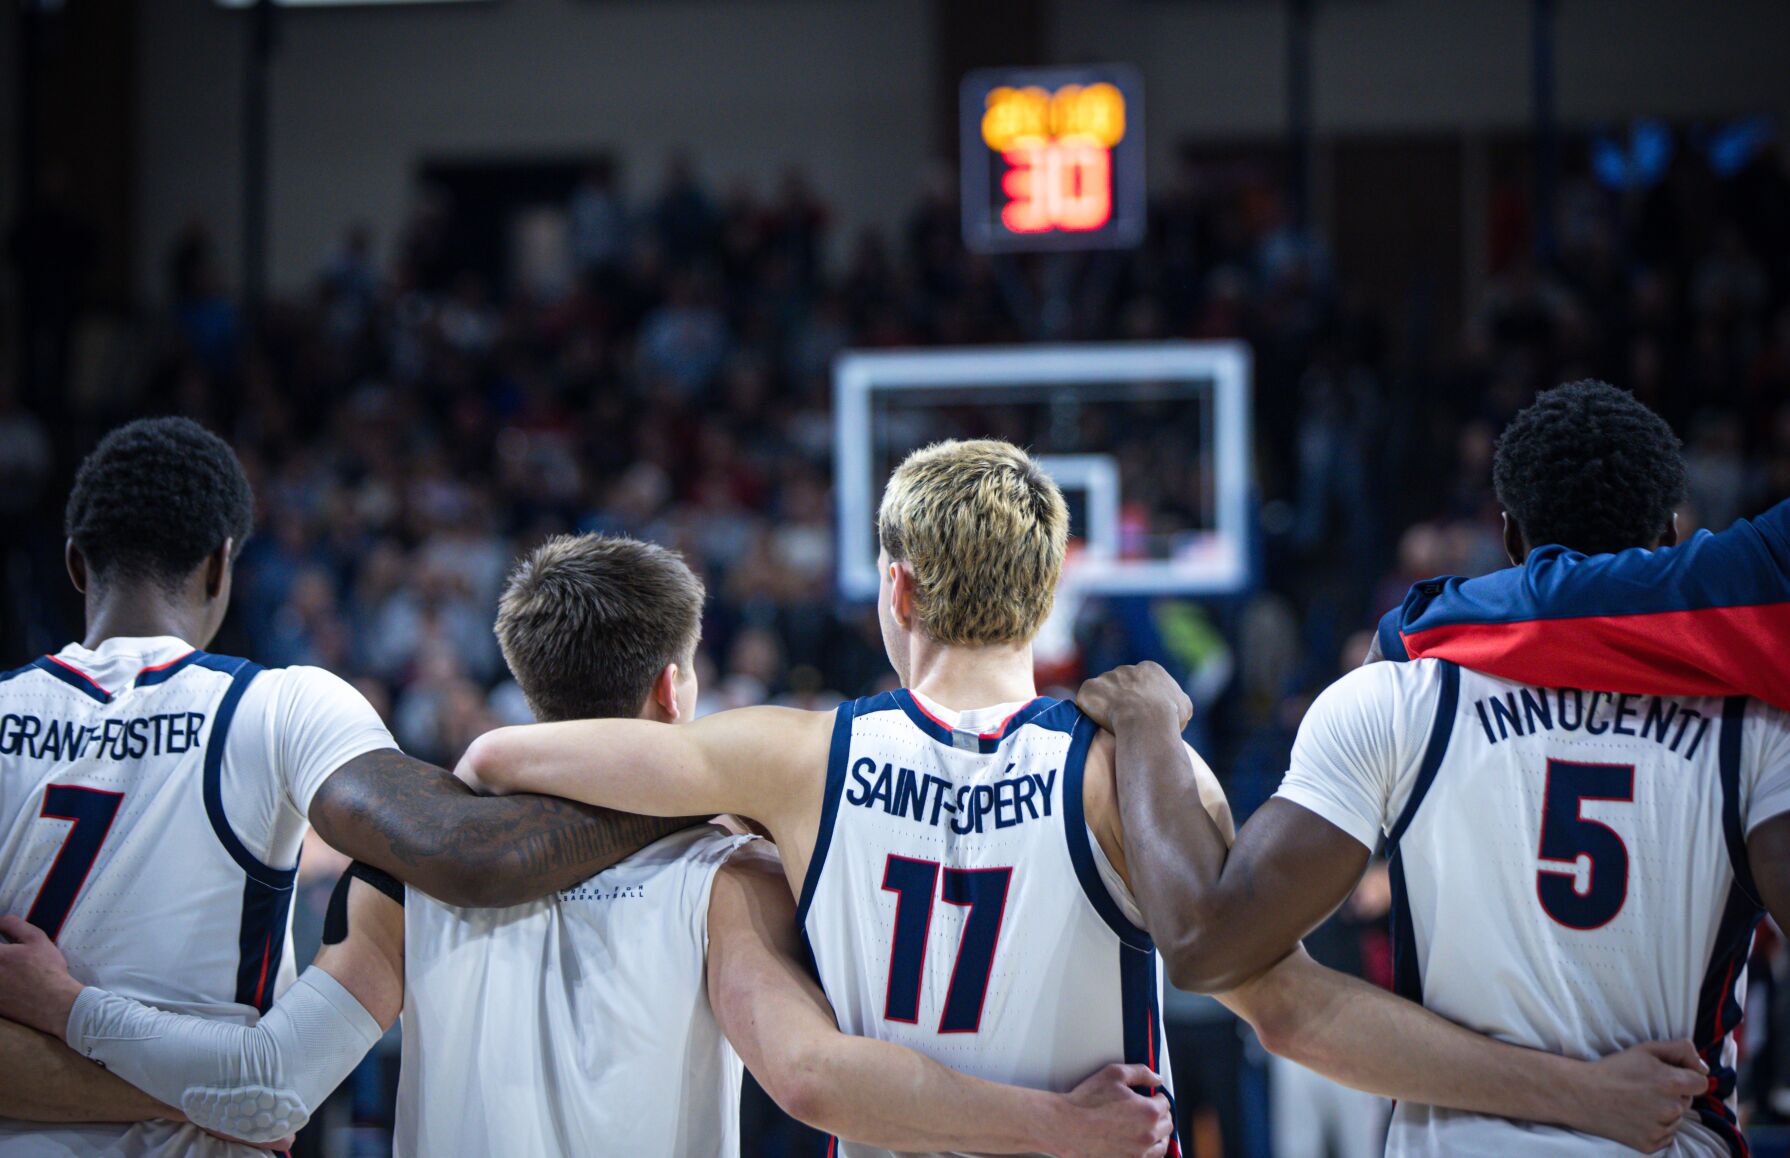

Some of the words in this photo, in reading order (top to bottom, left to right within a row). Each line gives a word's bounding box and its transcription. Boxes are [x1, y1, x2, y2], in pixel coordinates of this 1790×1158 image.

[1001, 136, 1112, 234] 30
[0, 712, 205, 762] GRANT-FOSTER
[1474, 686, 1710, 761] INNOCENTI
[25, 783, 125, 943] 7
[1536, 757, 1635, 931] 5
[563, 892, 644, 901] BASKETBALL
[881, 853, 1013, 1034] 17
